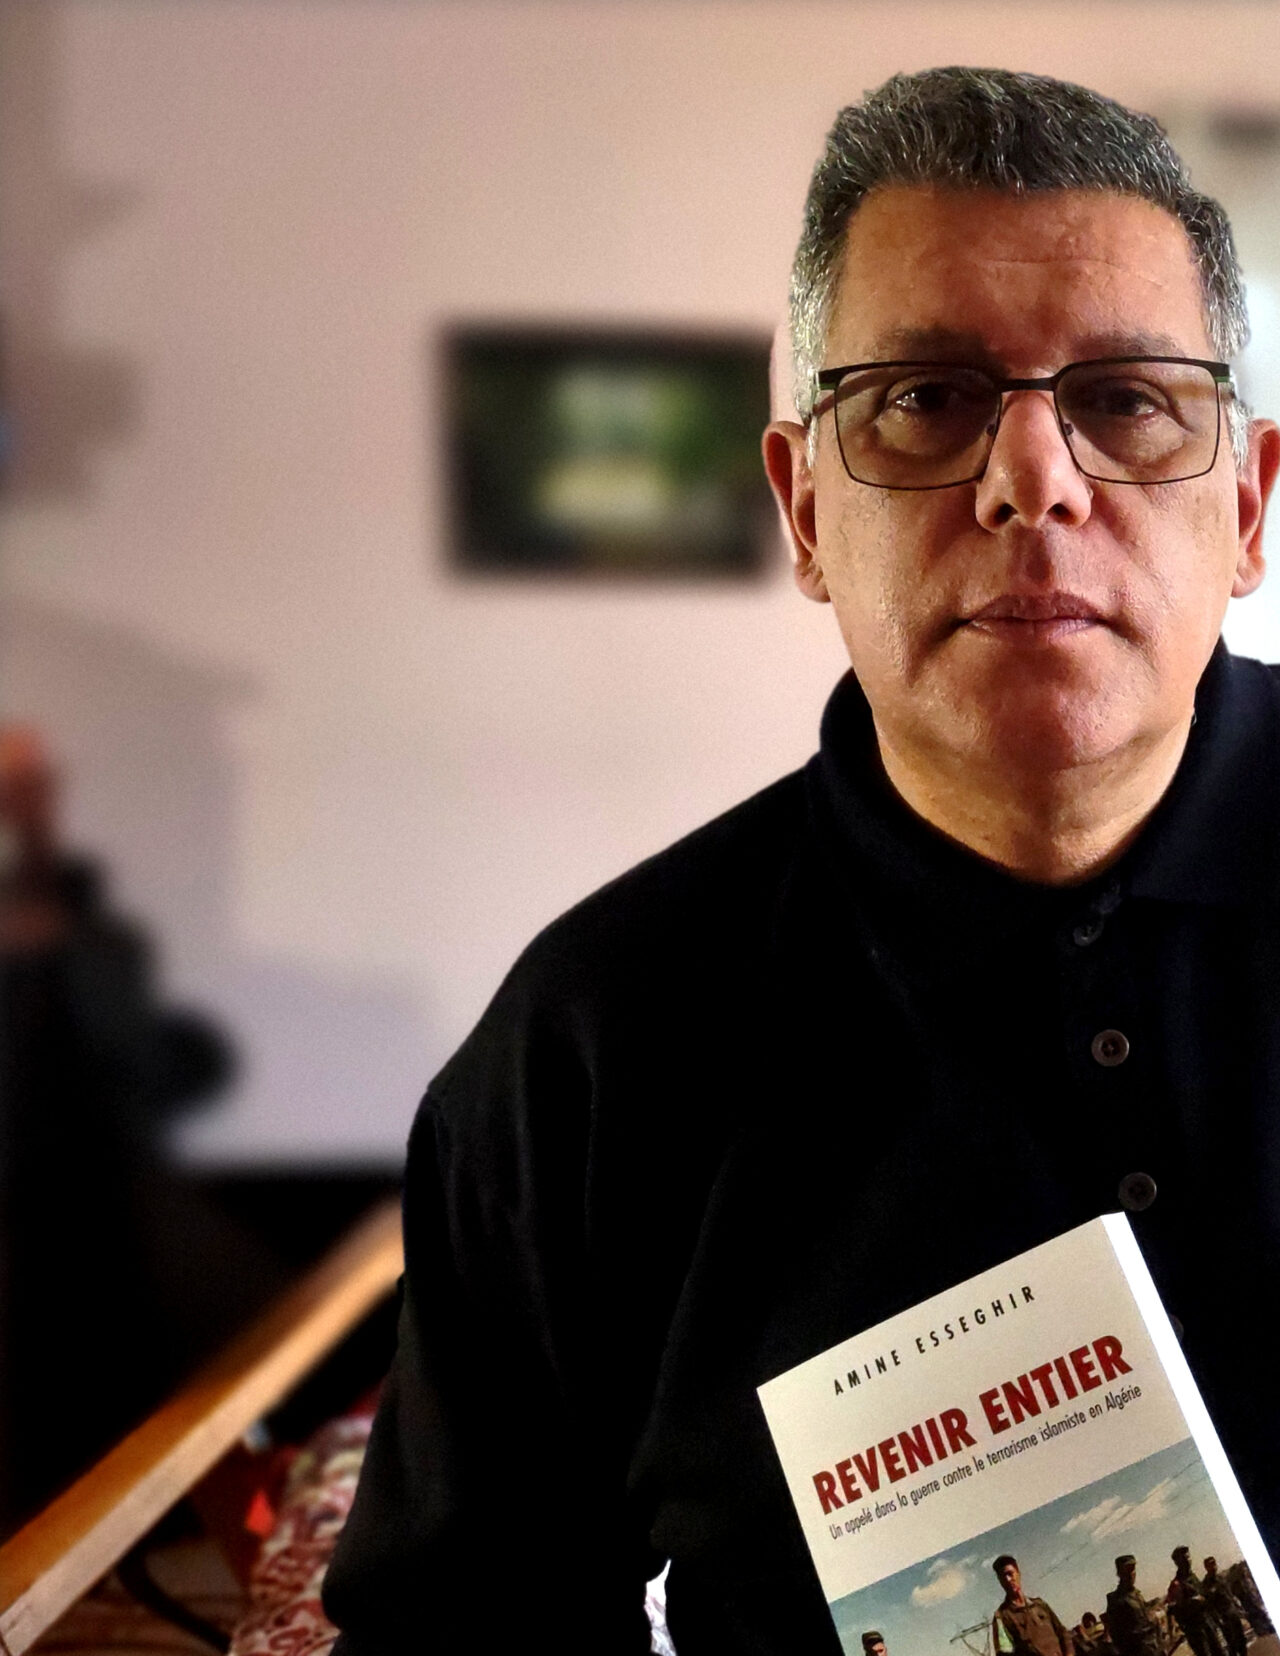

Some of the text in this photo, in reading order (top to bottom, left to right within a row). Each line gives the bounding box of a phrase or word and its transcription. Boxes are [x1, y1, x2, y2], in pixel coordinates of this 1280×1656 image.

[833, 1285, 1035, 1395] AMINE ESSEGHIR
[812, 1335, 1133, 1515] REVENIR ENTIER
[829, 1384, 1142, 1539] Un appelé dans la guerre contre le terrorisme islamiste en Algérie
